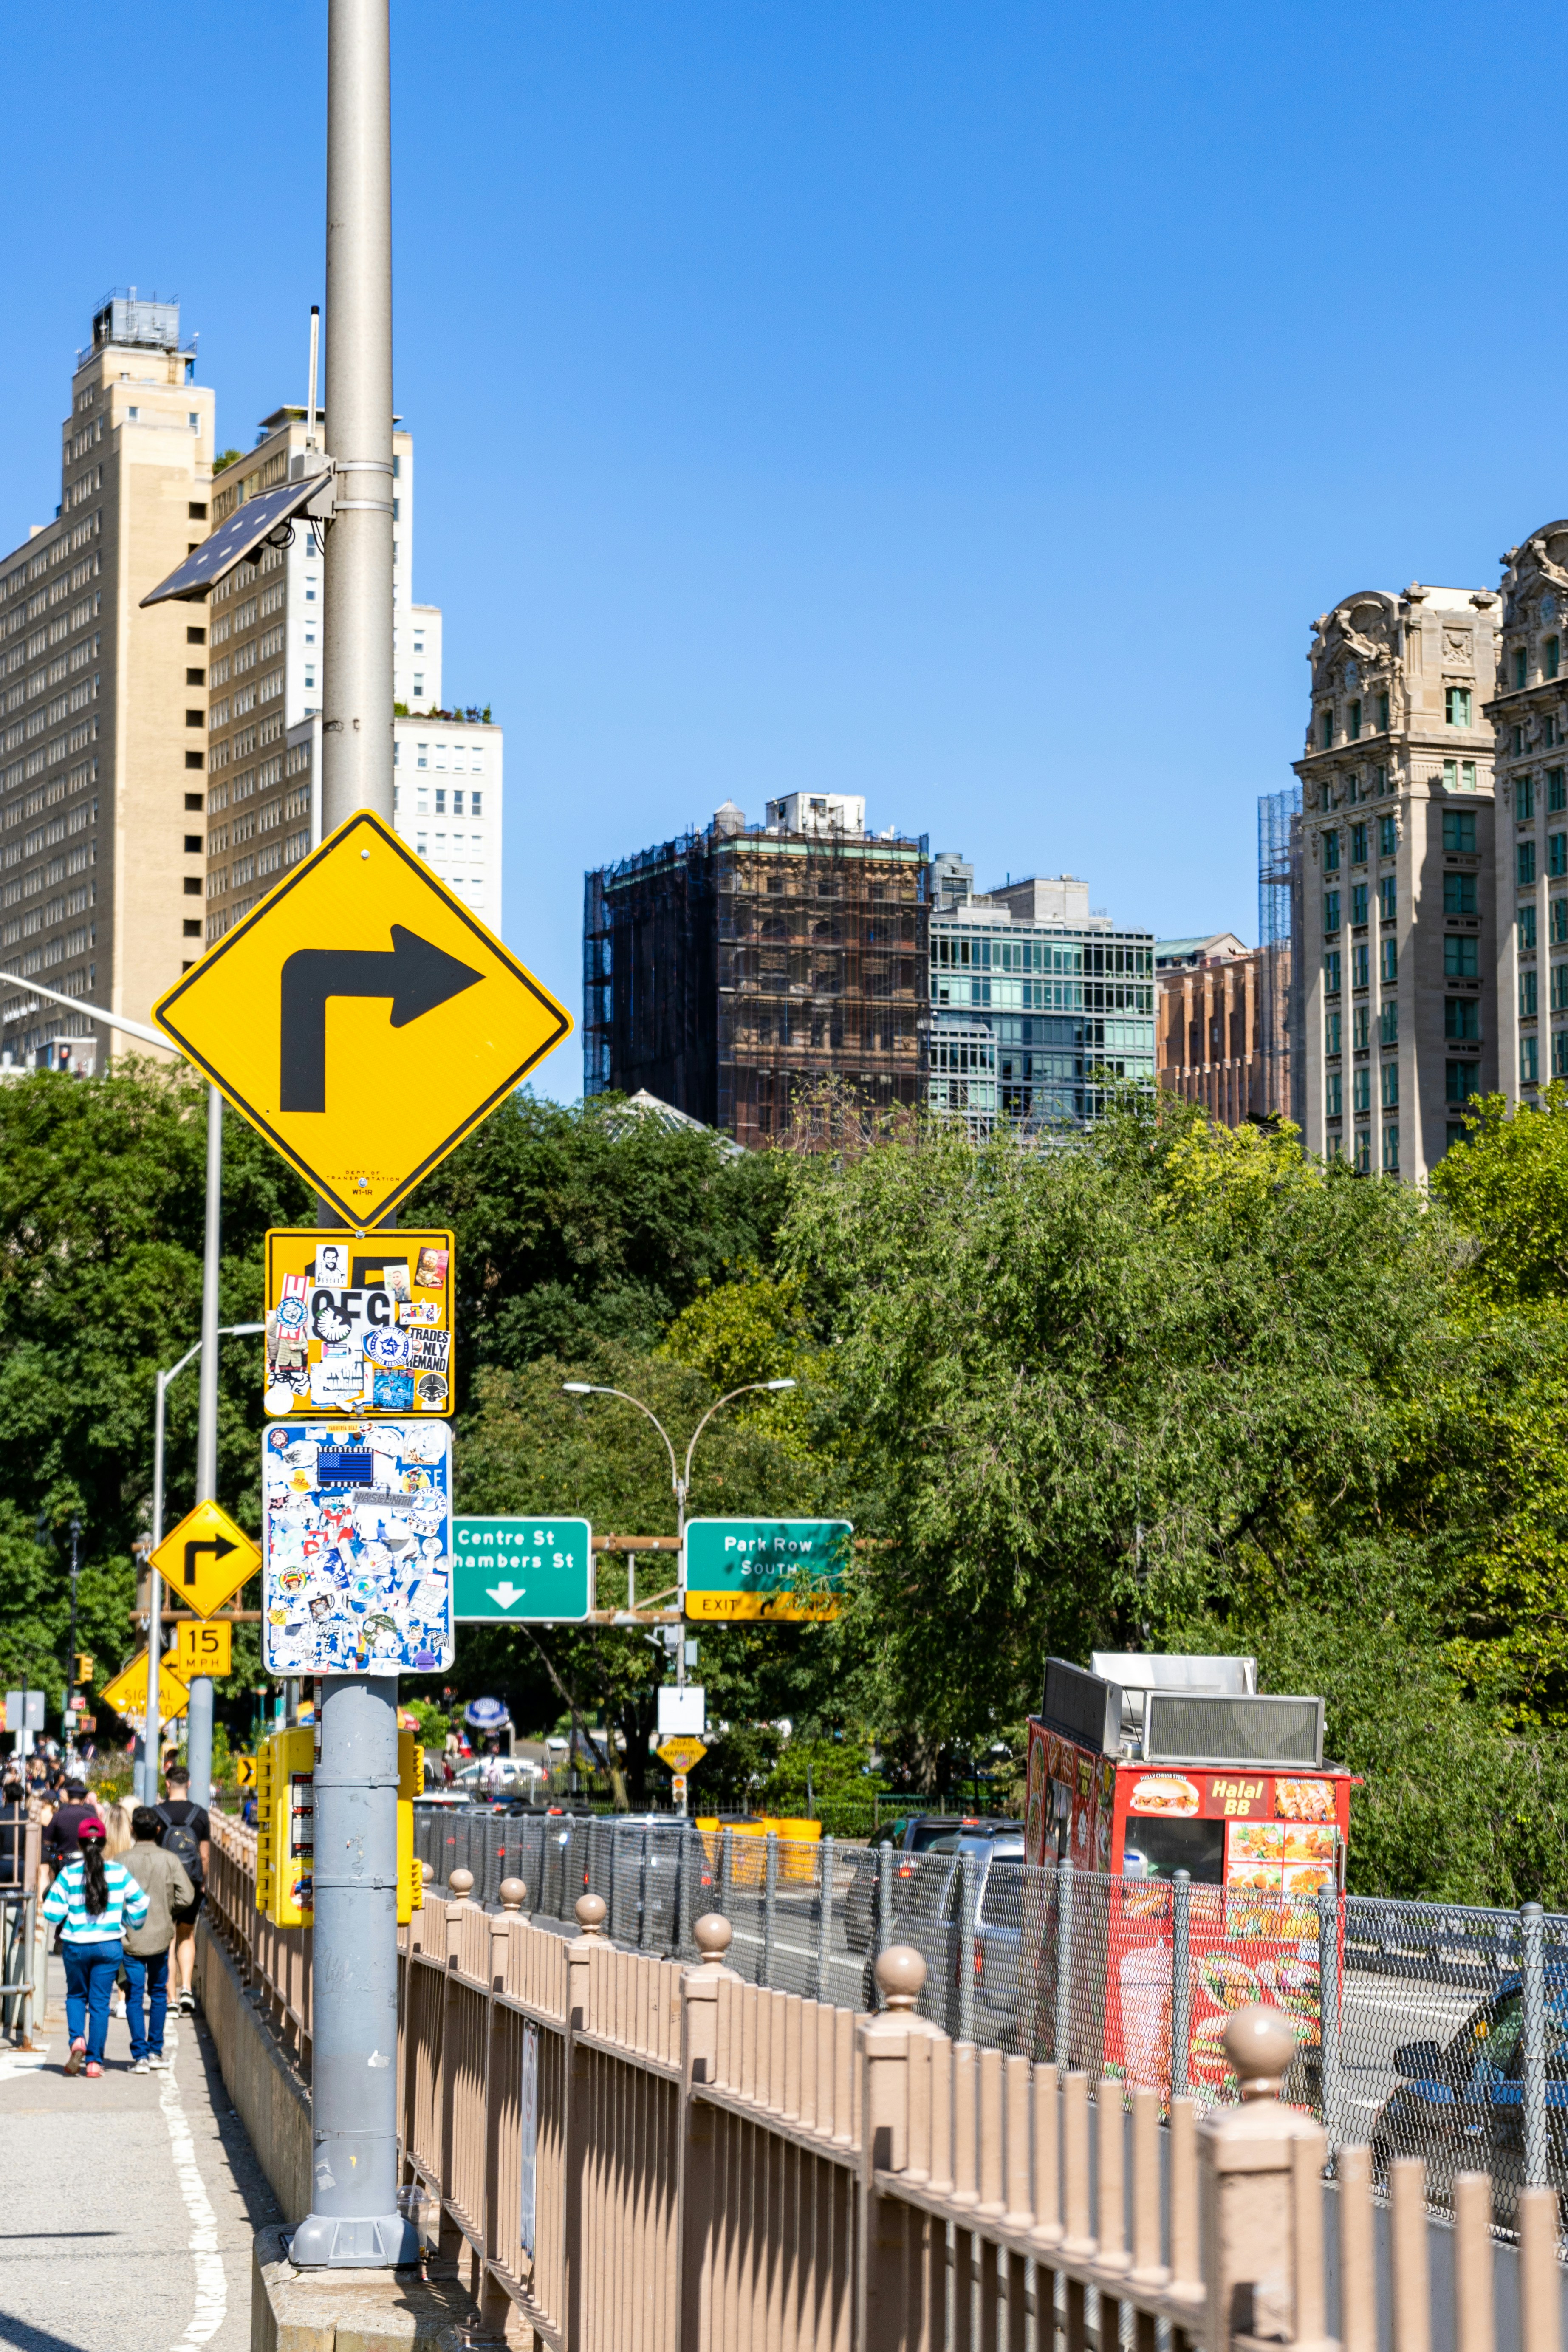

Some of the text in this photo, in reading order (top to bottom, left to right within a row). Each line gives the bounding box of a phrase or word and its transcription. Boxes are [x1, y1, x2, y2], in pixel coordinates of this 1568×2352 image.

[410, 1328, 449, 1343] TRADES
[417, 1488, 446, 1507] OSTKURVE
[411, 1510, 426, 1524] ERTHA
[429, 1516, 442, 1524] BSC
[458, 1529, 554, 1546] Centre St
[724, 1536, 812, 1552] Park Row
[453, 1552, 574, 1568] hambers St
[703, 1599, 738, 1611] EXIT
[189, 1630, 218, 1653] 15
[125, 1689, 174, 1701] SIGAL
[127, 1706, 173, 1716] AHAD
[1140, 1774, 1156, 1782] PHILLY
[1212, 1780, 1263, 1799] Halal
[1224, 1798, 1251, 1816] BB
